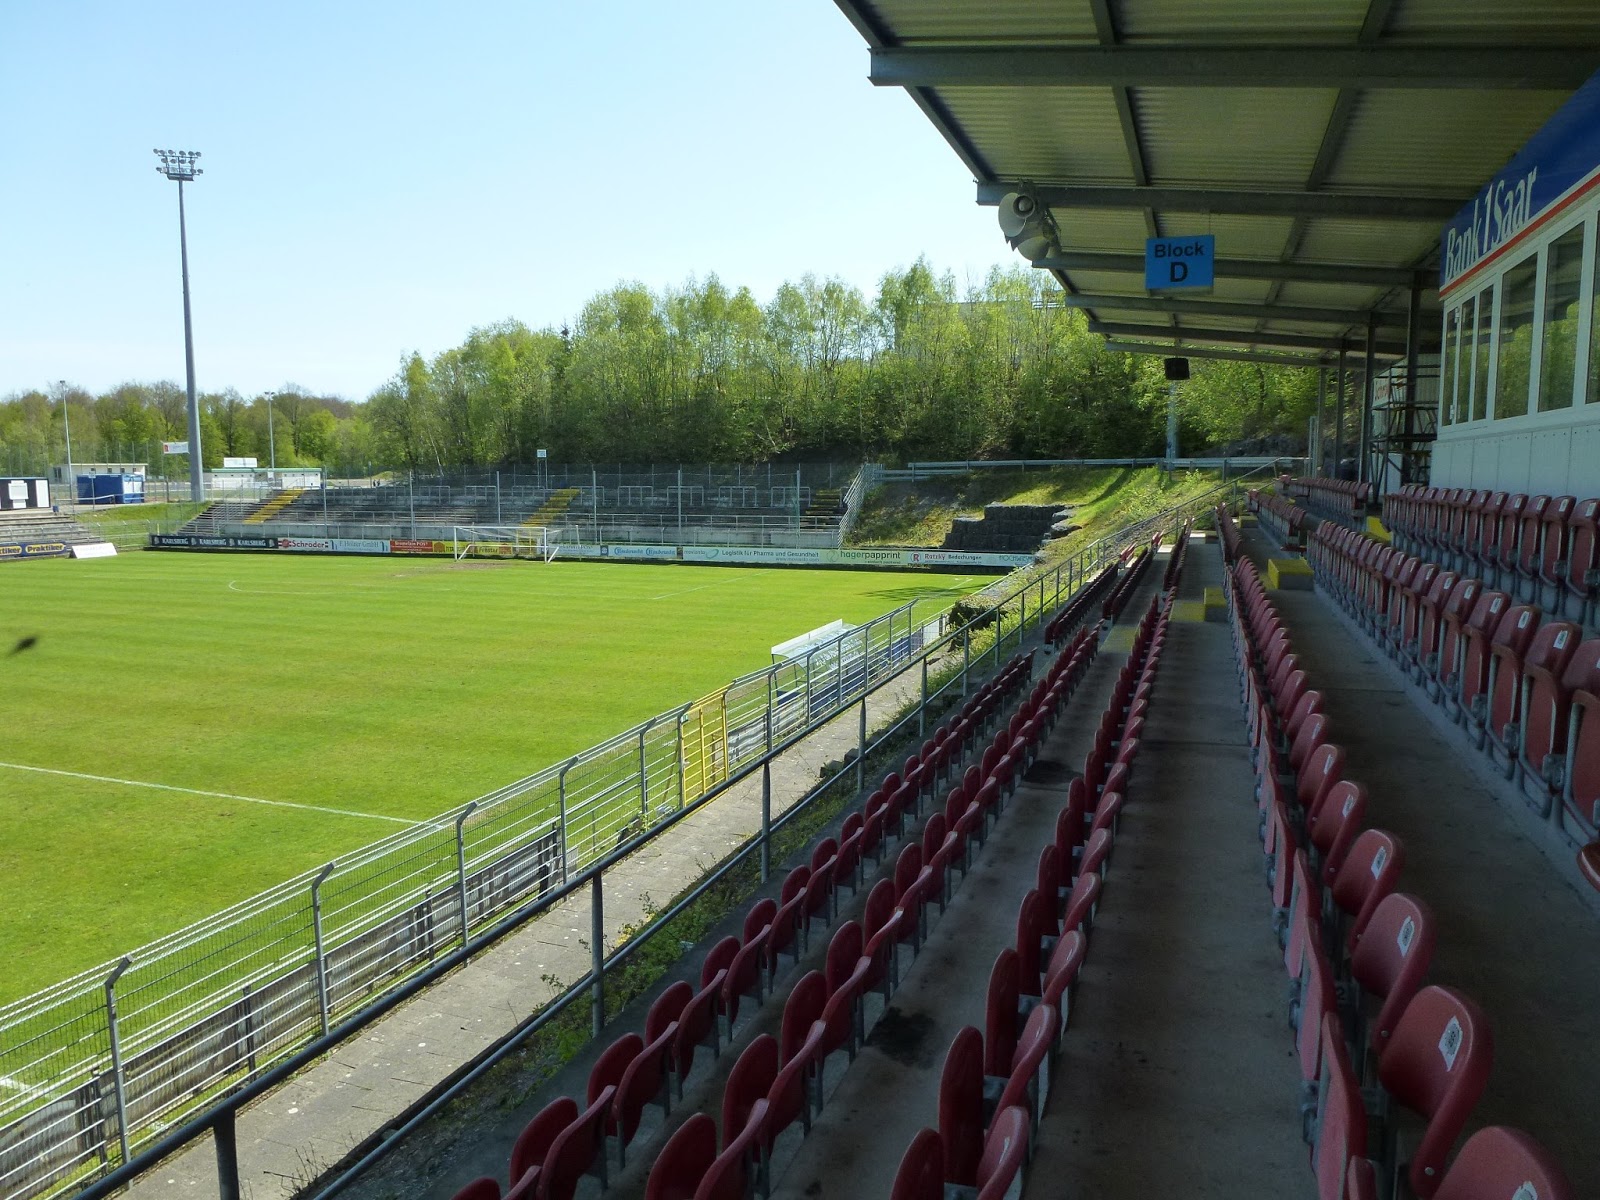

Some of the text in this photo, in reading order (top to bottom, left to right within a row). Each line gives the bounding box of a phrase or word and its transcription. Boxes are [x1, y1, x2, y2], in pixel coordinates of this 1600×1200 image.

[1154, 242, 1204, 258] Block
[1170, 261, 1188, 283] D
[199, 538, 227, 546] KARLSBERG
[27, 544, 63, 552] Praktiker
[840, 550, 901, 560] hagerpapprint
[913, 554, 920, 562] R
